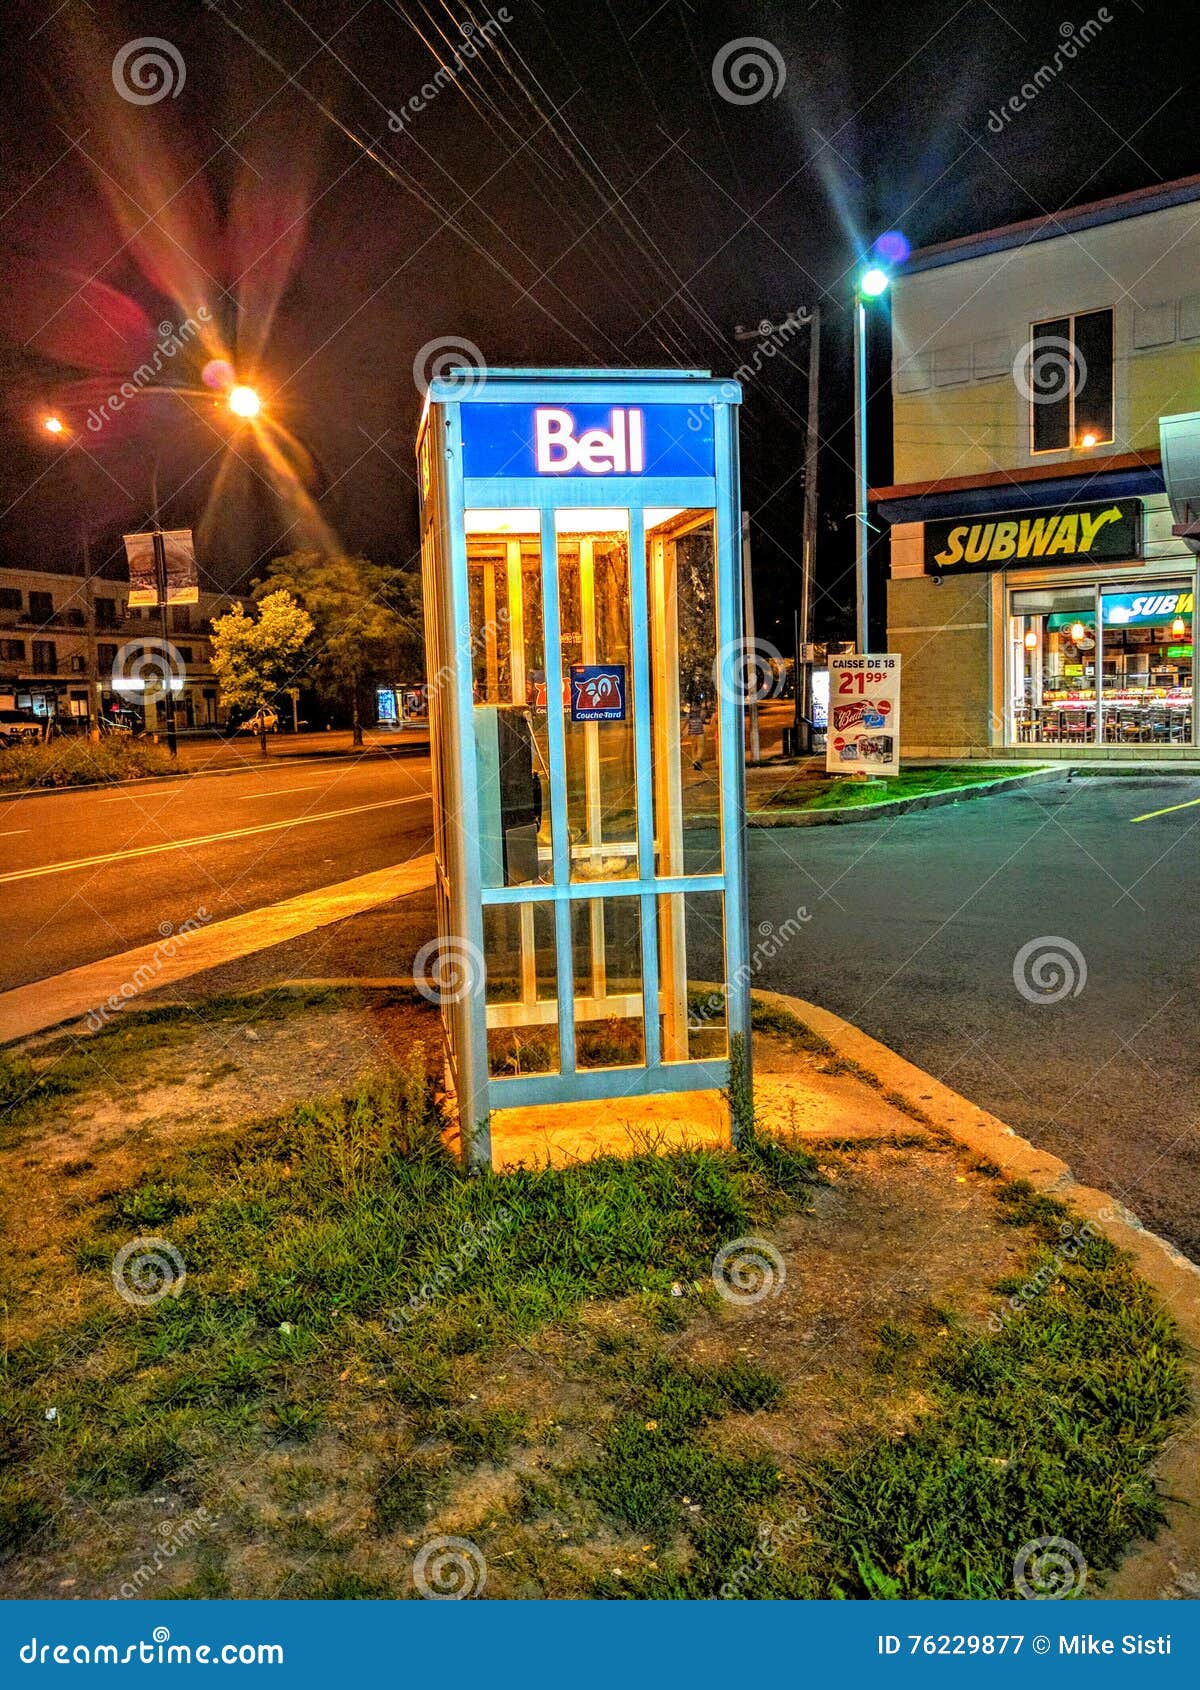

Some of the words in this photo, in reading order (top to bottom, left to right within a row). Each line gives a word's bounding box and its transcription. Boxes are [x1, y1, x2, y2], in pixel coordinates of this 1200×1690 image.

[535, 408, 643, 473] Bell
[934, 505, 1123, 568] SUBWAY
[832, 659, 865, 669] CAISSE
[867, 659, 881, 669] DE
[884, 659, 895, 668] 18
[576, 711, 621, 719] Couche-Tard
